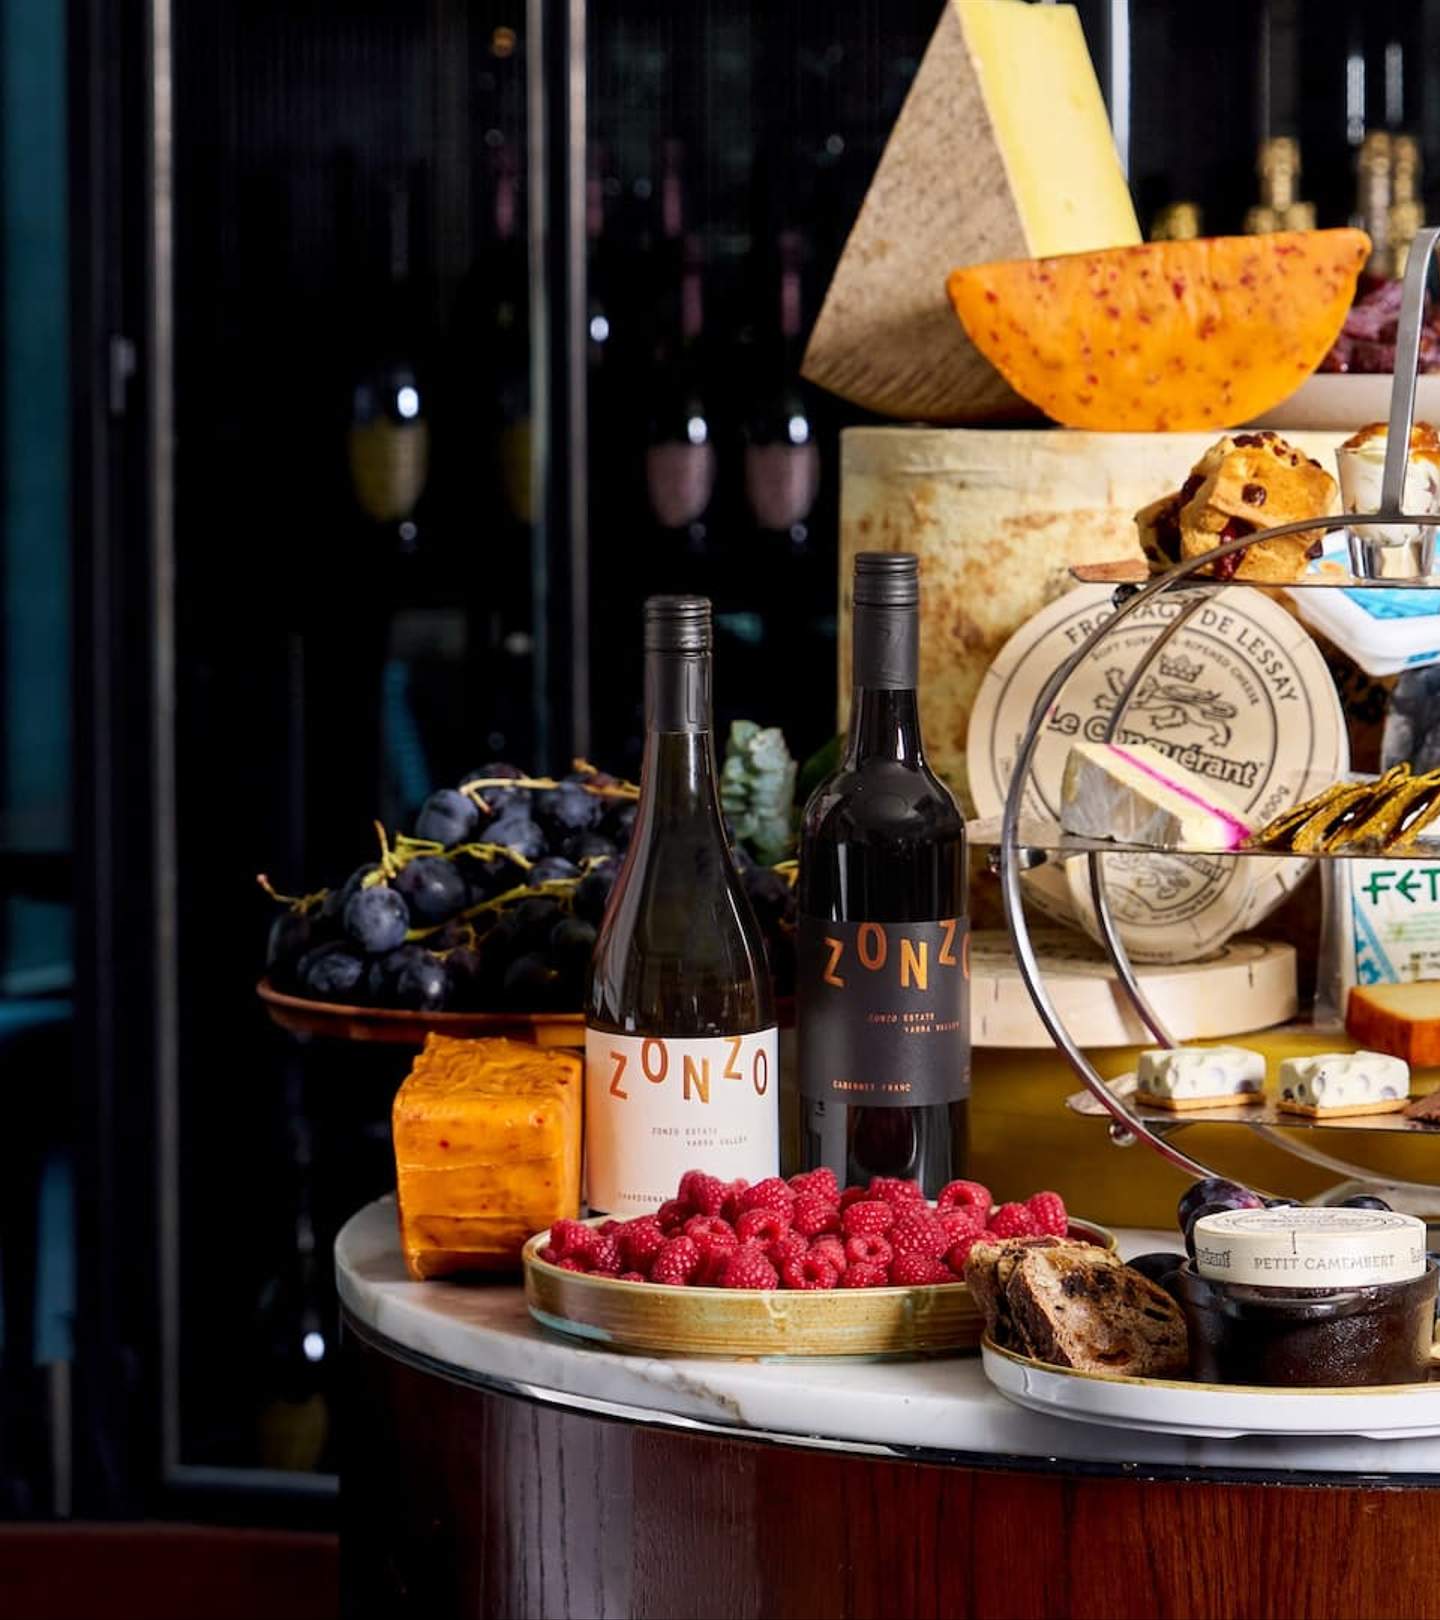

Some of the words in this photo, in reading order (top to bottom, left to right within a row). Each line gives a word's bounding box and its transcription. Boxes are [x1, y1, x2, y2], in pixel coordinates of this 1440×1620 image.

[1065, 602, 1177, 645] FROAG
[1201, 609, 1234, 634] DE
[1236, 626, 1298, 701] LESSAY
[1046, 704, 1080, 735] Le
[903, 1012, 935, 1023] ESTATE
[609, 1035, 768, 1105] ZONZO
[1253, 1256, 1299, 1270] PETIT
[1303, 1254, 1396, 1270] CAMEMBERT
